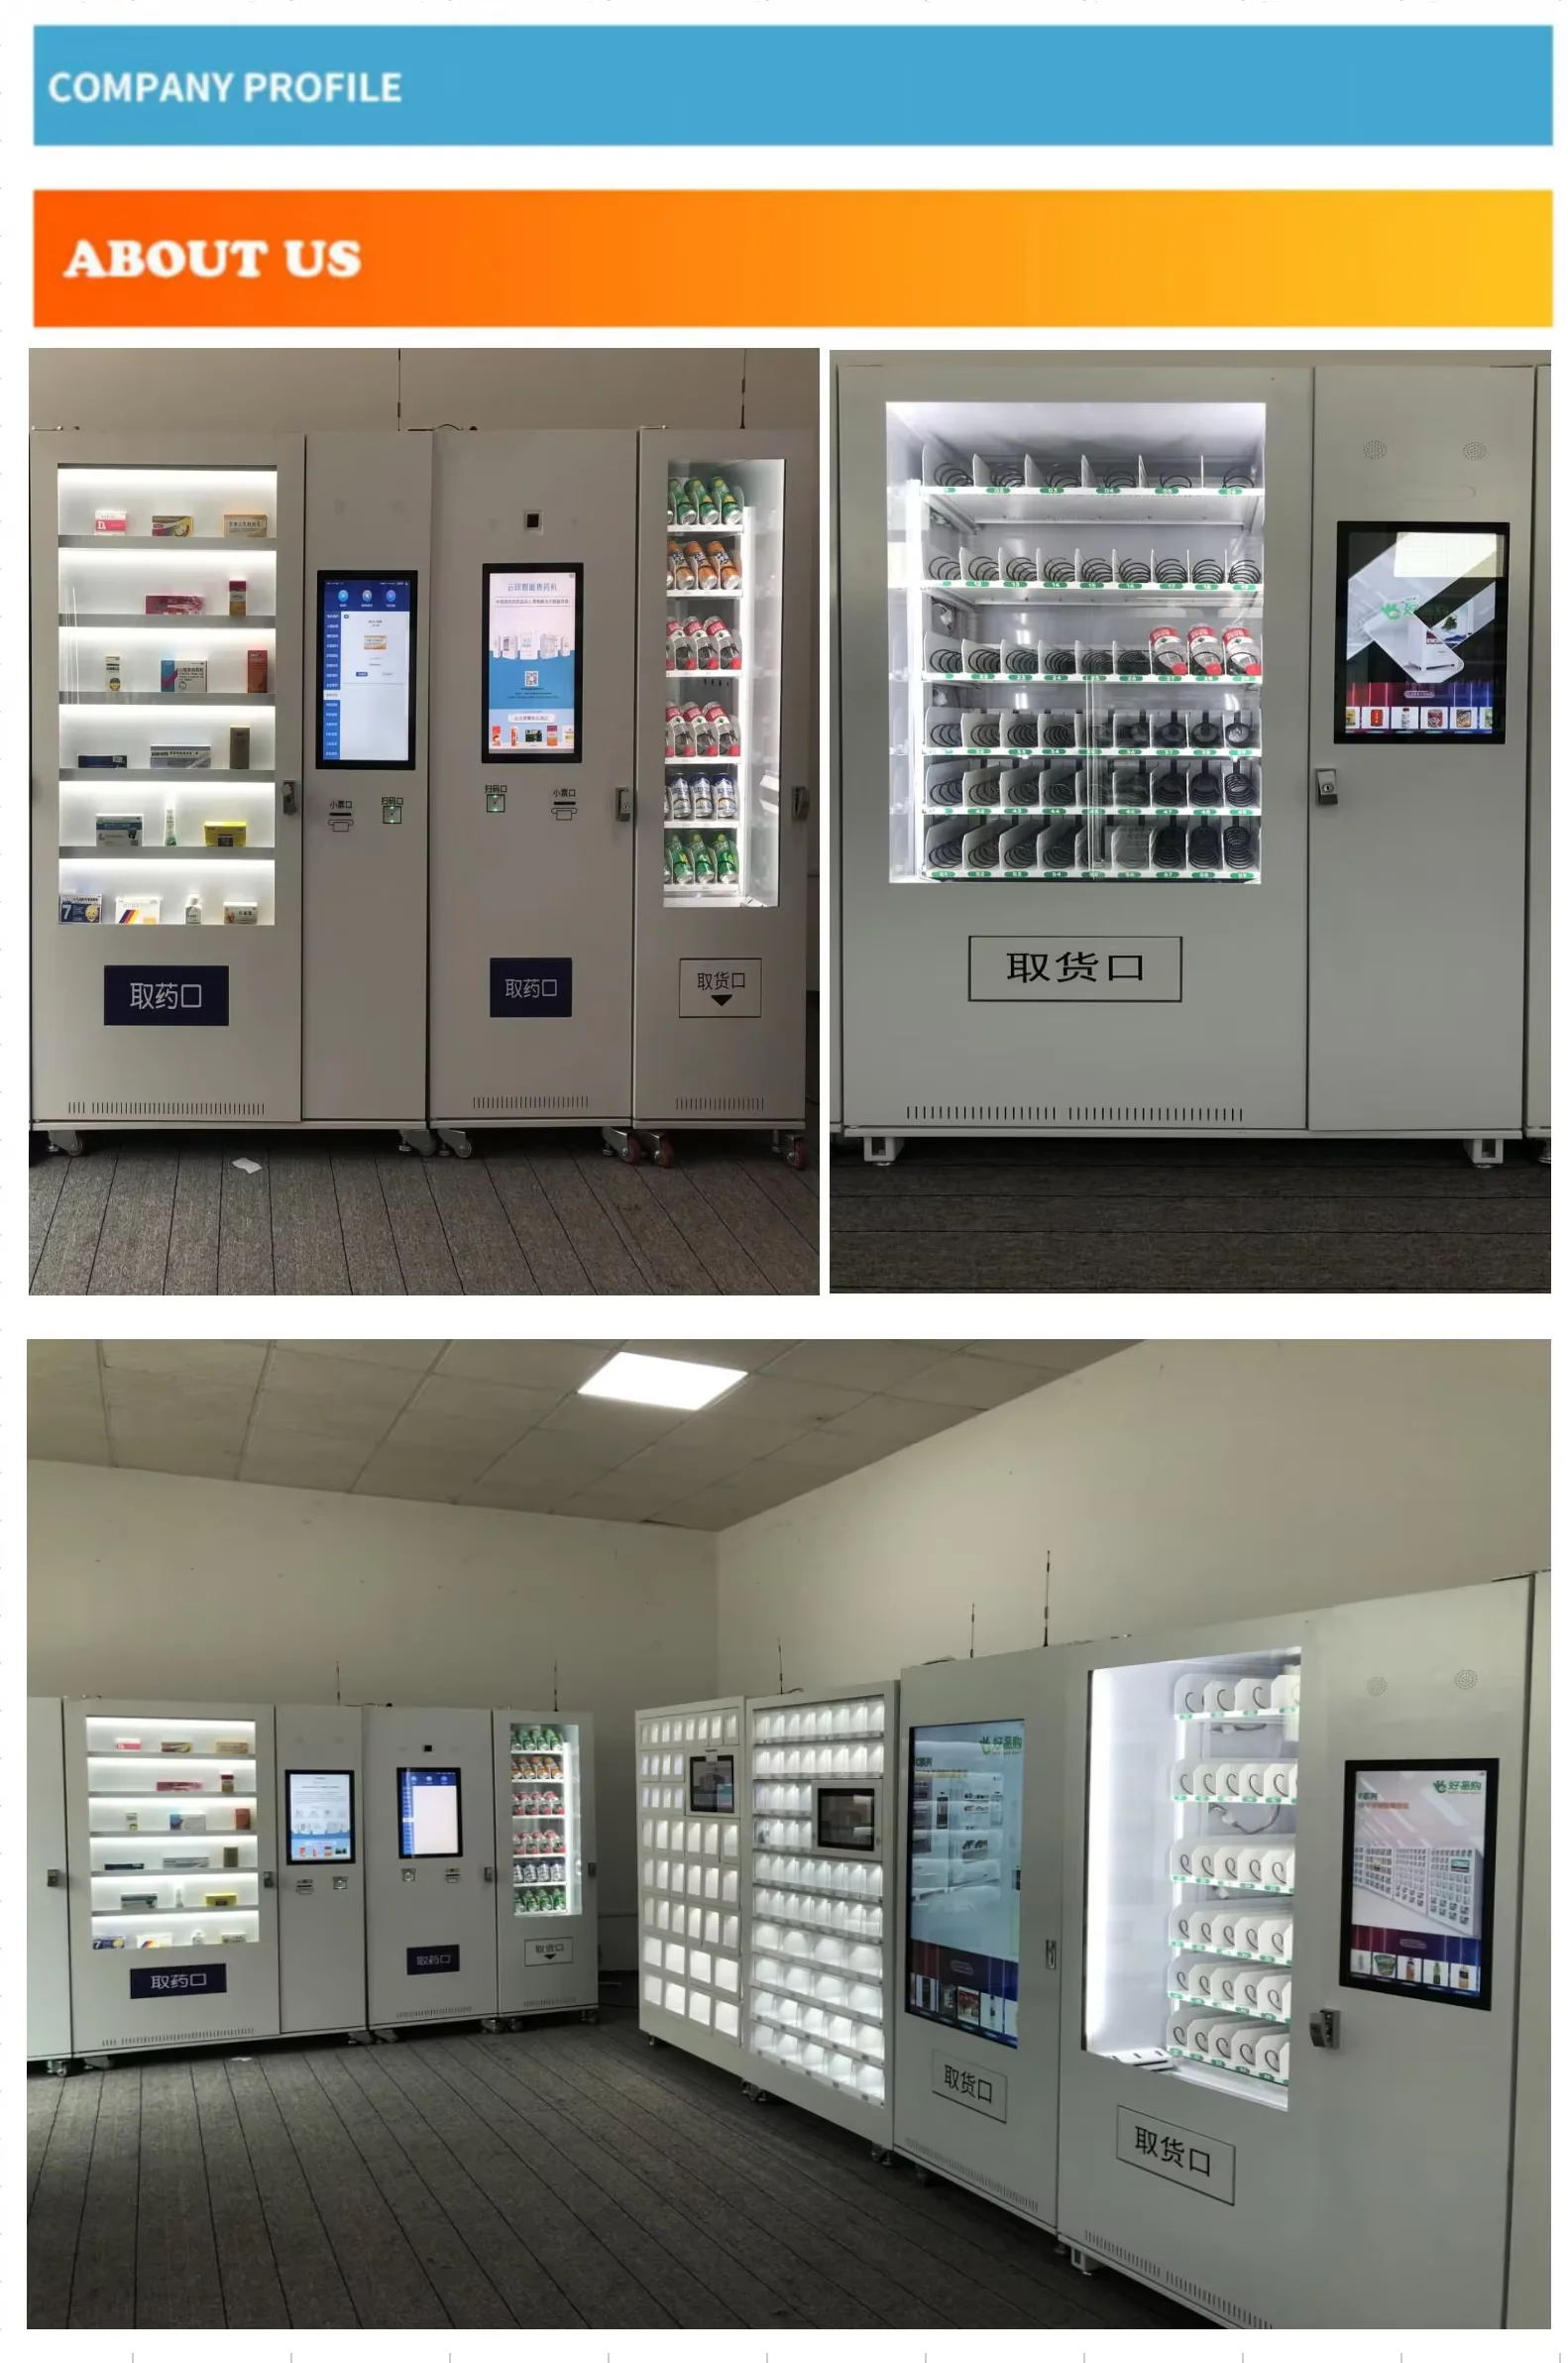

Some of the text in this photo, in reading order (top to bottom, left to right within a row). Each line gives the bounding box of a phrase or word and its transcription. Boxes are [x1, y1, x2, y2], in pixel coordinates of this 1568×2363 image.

[62, 904, 72, 920] 7
[1006, 951, 1144, 983] 取货口
[504, 977, 558, 998] 取药口
[697, 971, 745, 991] 取货口
[130, 982, 202, 1010] 取药口
[416, 1954, 451, 1966] 取药口
[151, 1972, 207, 1989] 取药口
[944, 2064, 992, 2104] 取货口
[1135, 2125, 1210, 2178] 取货口
